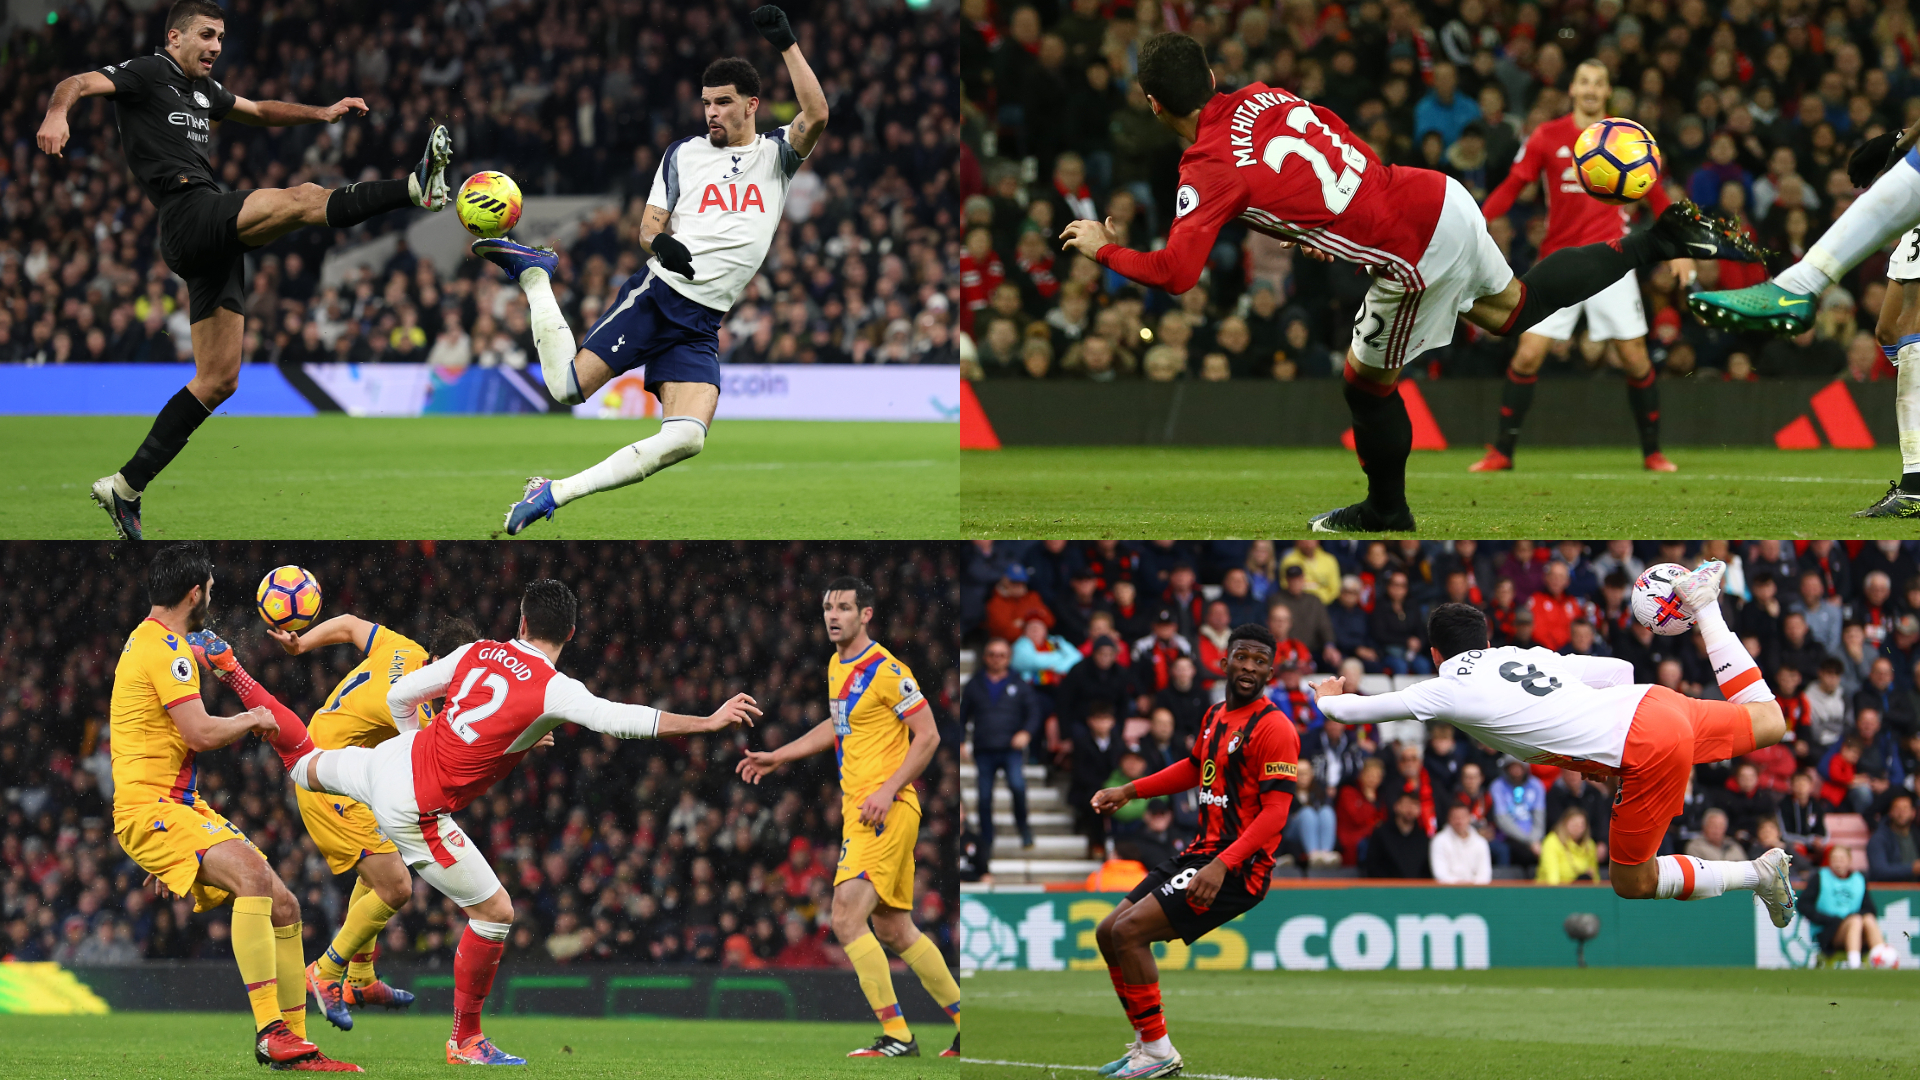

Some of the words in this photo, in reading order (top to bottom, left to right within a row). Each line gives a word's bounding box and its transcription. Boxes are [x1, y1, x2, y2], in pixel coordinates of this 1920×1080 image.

[1262, 105, 1368, 215] 22
[697, 183, 766, 213] AIA
[478, 647, 533, 682] GIROUD
[1498, 661, 1563, 697] 8
[446, 667, 510, 745] 12
[1170, 867, 1198, 890] 8
